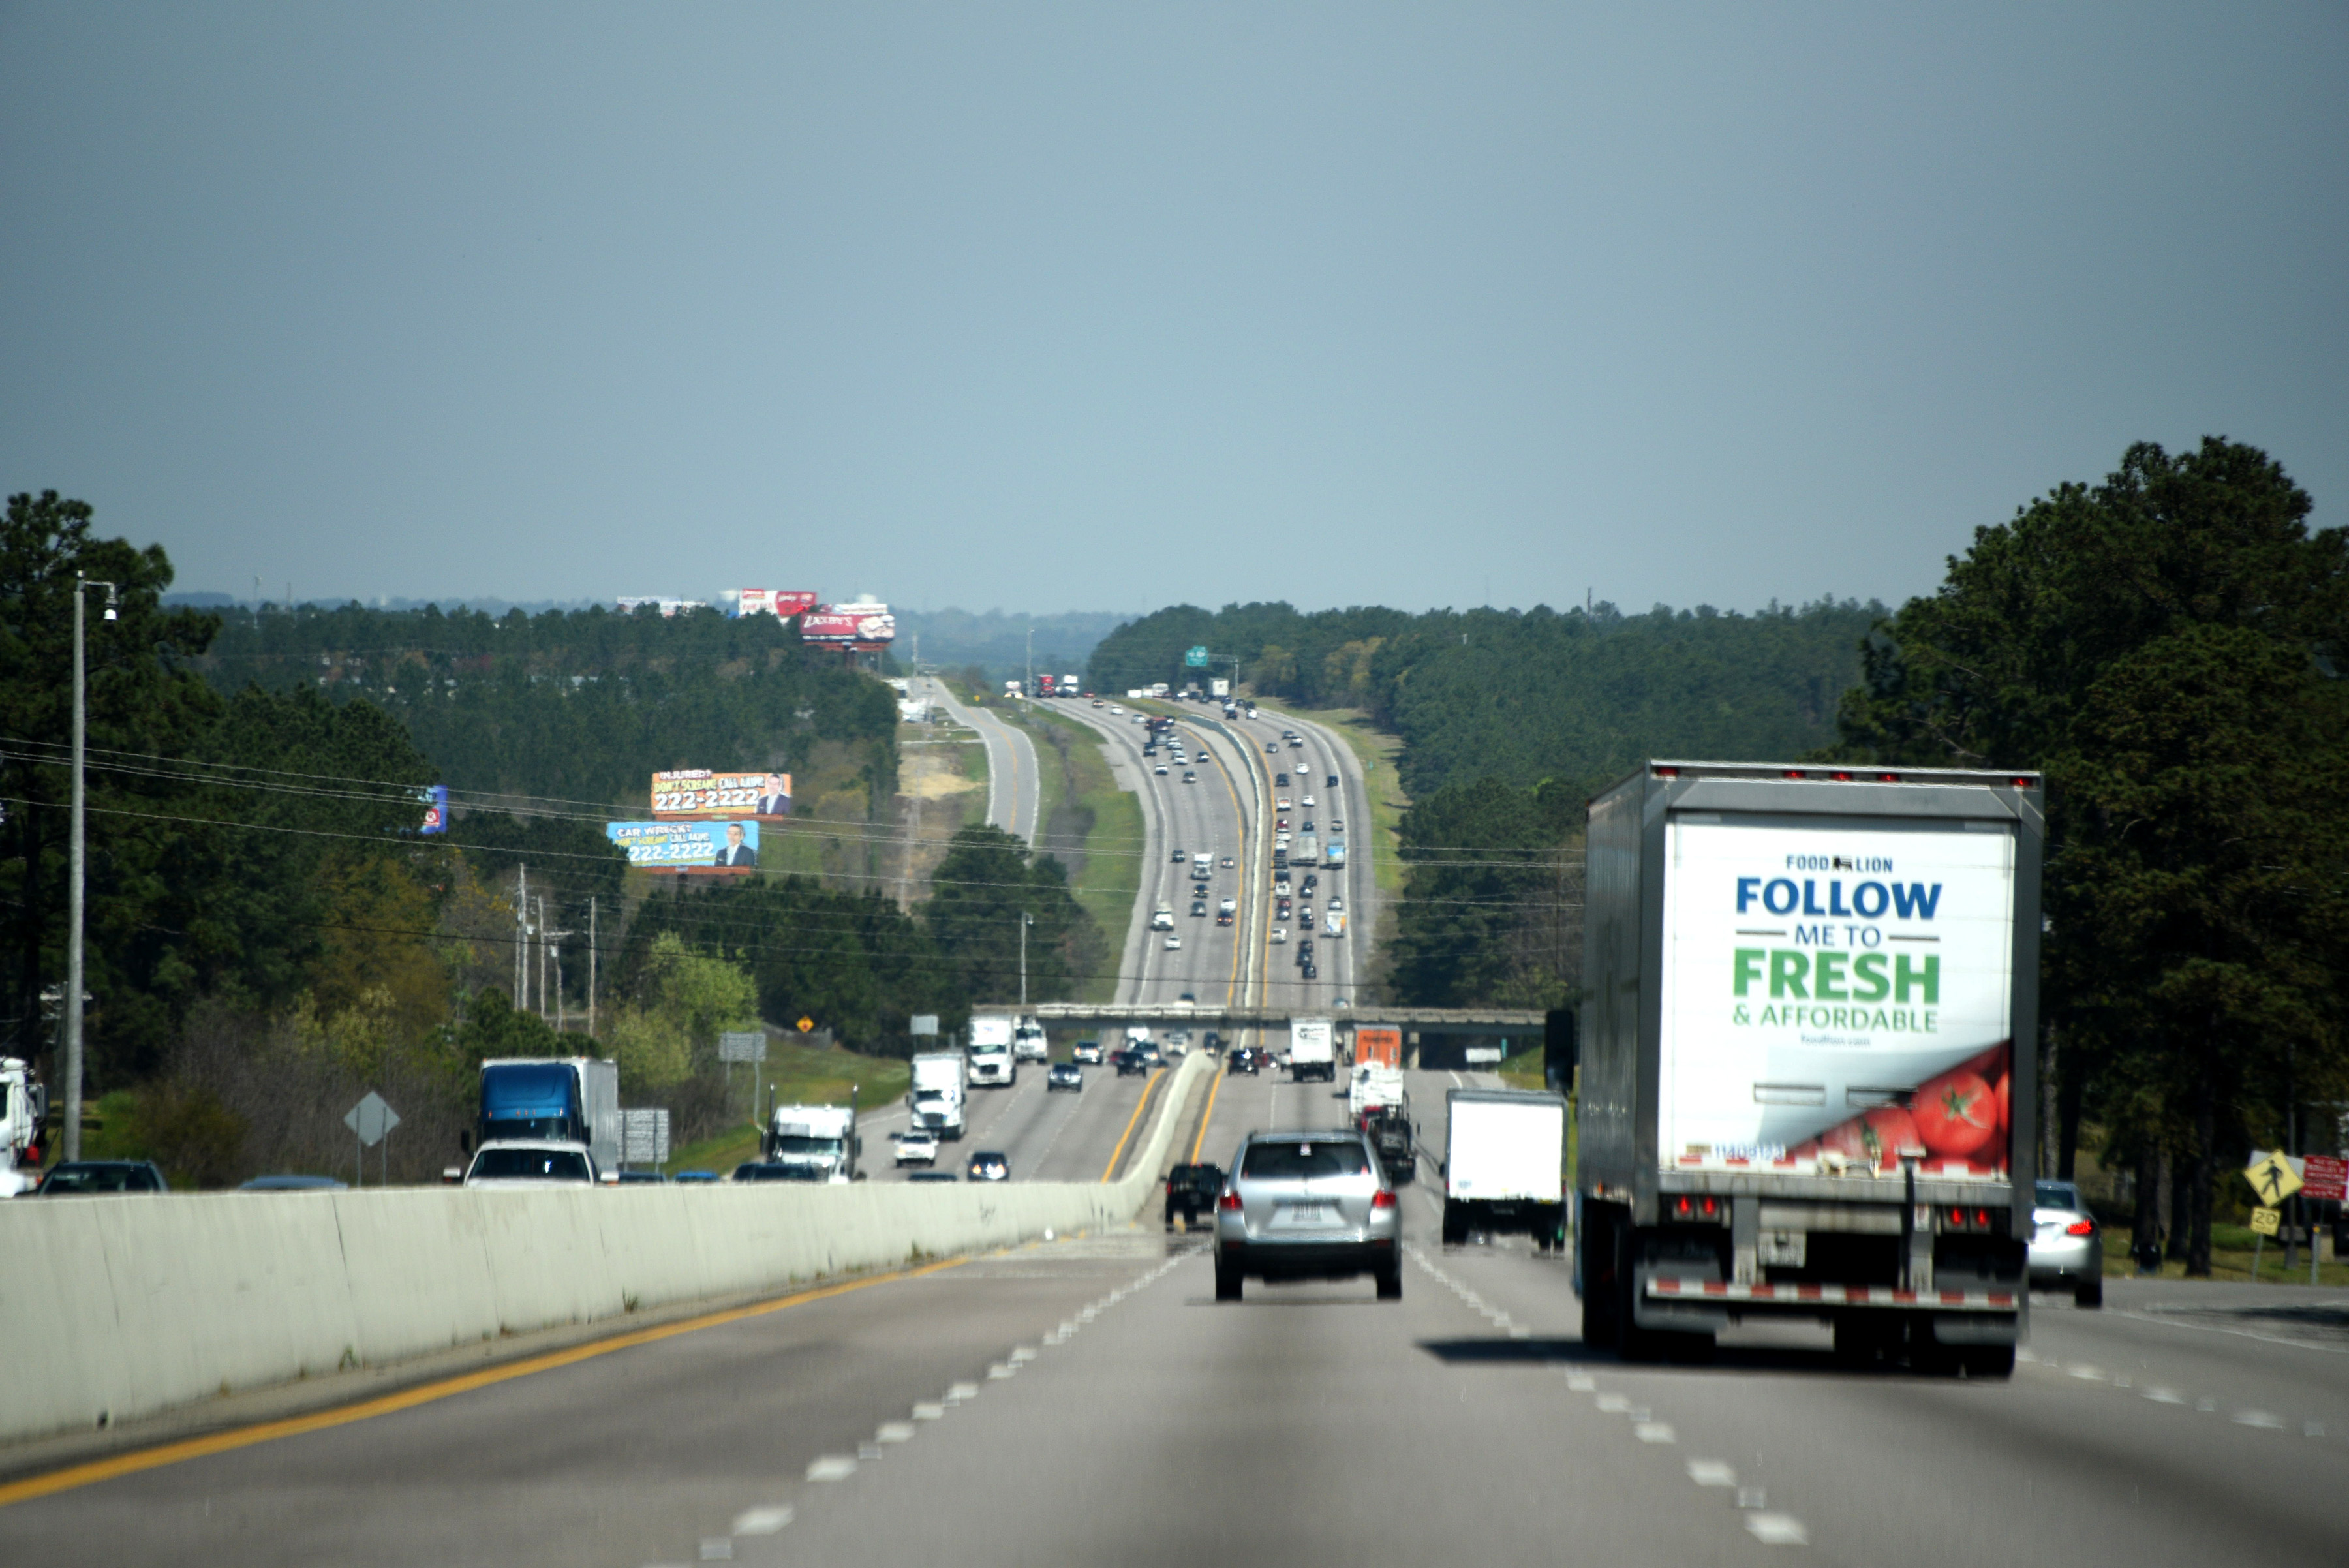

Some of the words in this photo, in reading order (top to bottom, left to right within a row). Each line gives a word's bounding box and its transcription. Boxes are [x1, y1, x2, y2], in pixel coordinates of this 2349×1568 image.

[659, 769, 712, 780] INJURED?
[654, 789, 760, 811] 222-2222
[617, 828, 641, 837] CAR
[643, 823, 692, 835] WRECK?
[628, 842, 714, 862] 222-2222
[1786, 855, 1829, 870] FOOD
[1856, 857, 1893, 873] LION
[1735, 876, 1942, 921] FOLLOW
[1795, 925, 1834, 947] ME
[1843, 926, 1881, 948] TO
[1733, 947, 1941, 1005] FRESH
[1733, 1003, 1750, 1027] &
[1760, 1004, 1939, 1033] AFFORDABLE
